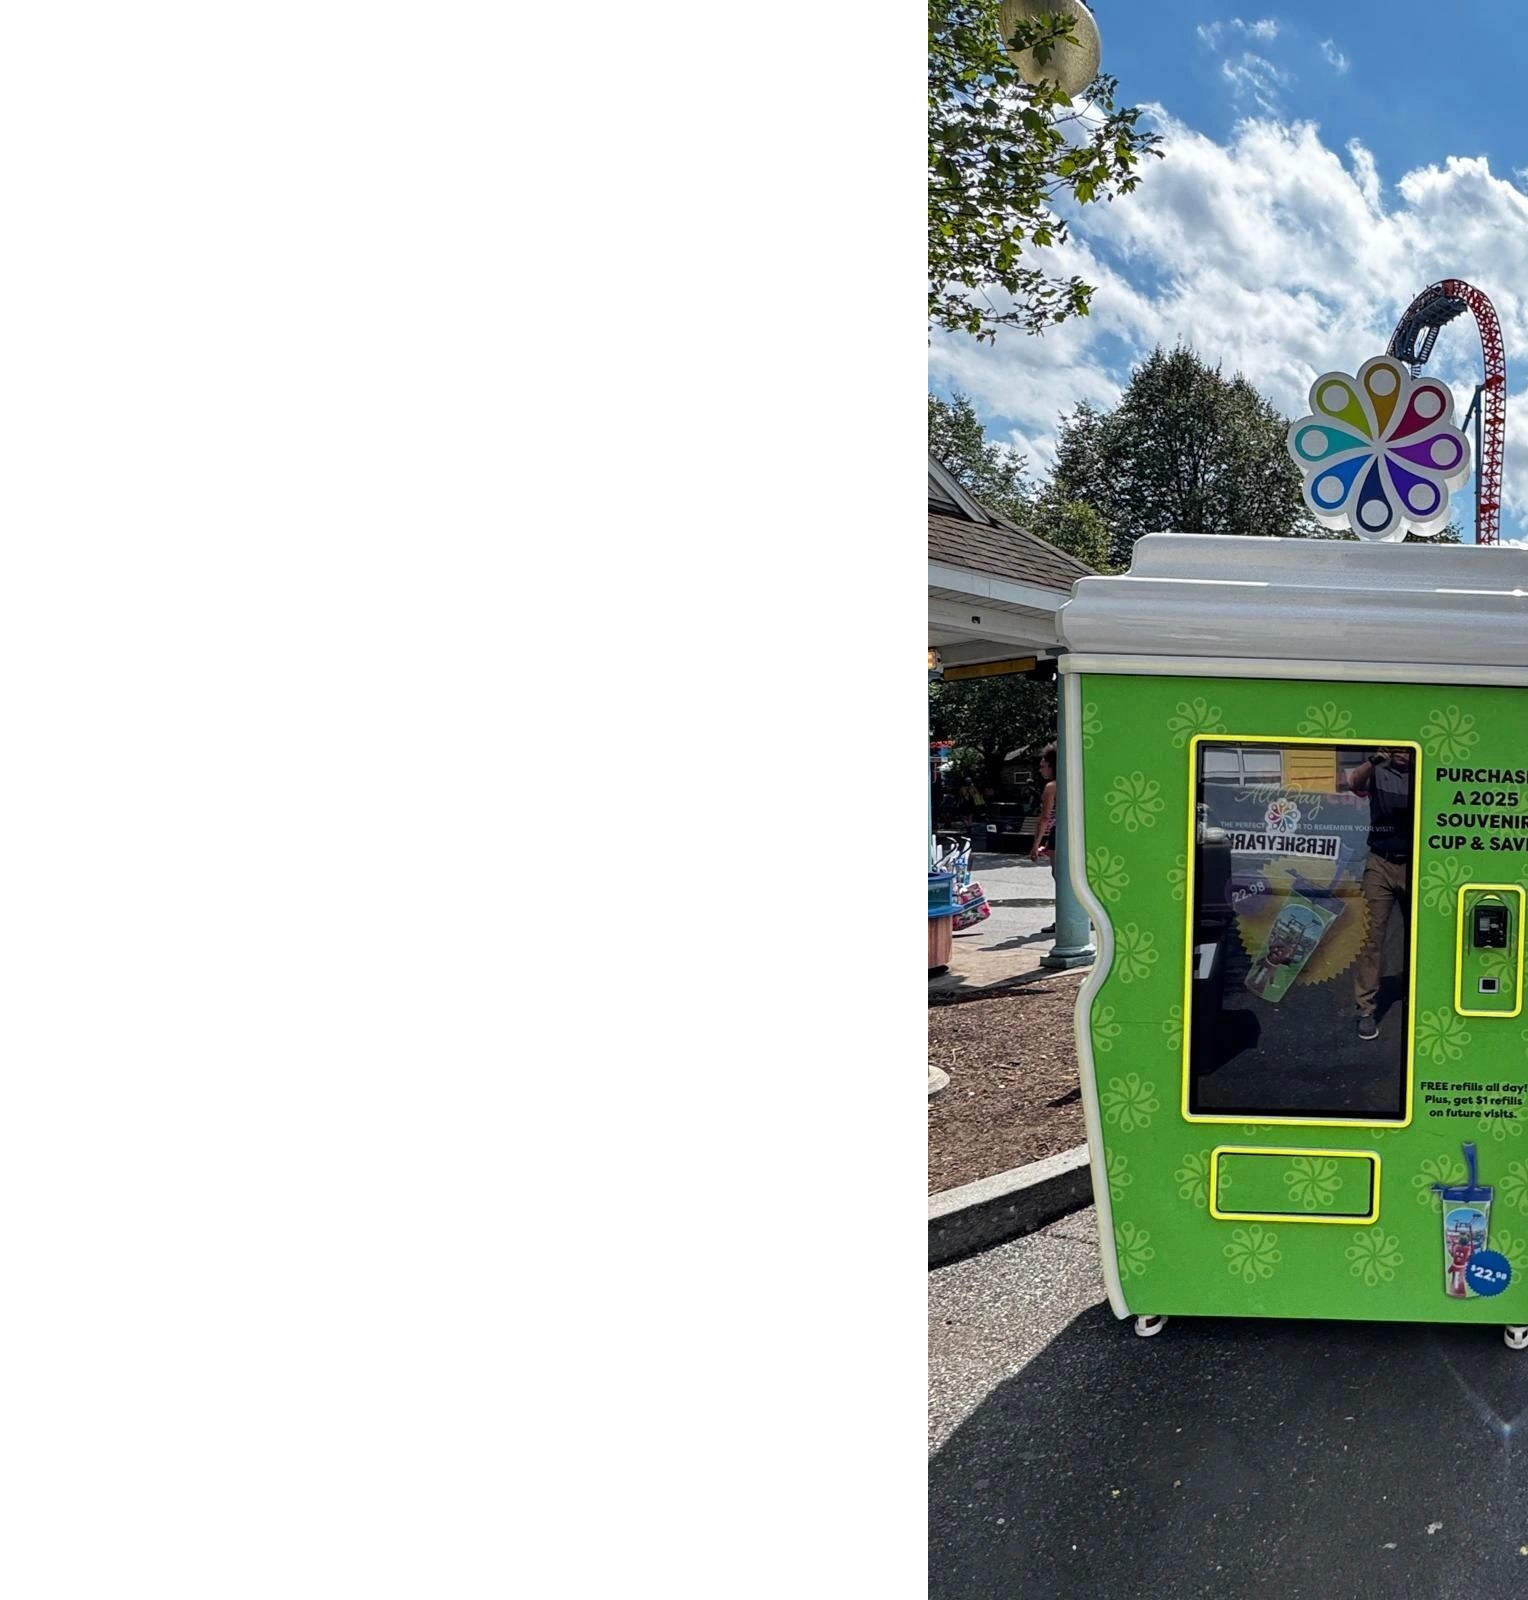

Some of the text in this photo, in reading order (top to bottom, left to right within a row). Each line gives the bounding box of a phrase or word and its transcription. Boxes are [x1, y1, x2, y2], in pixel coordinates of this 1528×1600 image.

[1281, 783, 1324, 820] Day
[1452, 790, 1519, 806] A 2025
[1235, 821, 1266, 829] PERFECT
[1428, 835, 1467, 849] CUP
[1470, 836, 1485, 850] &
[1420, 1082, 1528, 1094] FREE refills all day!
[1425, 1095, 1522, 1106] Plus, get $1 refills
[1429, 1108, 1517, 1118] on future visits.
